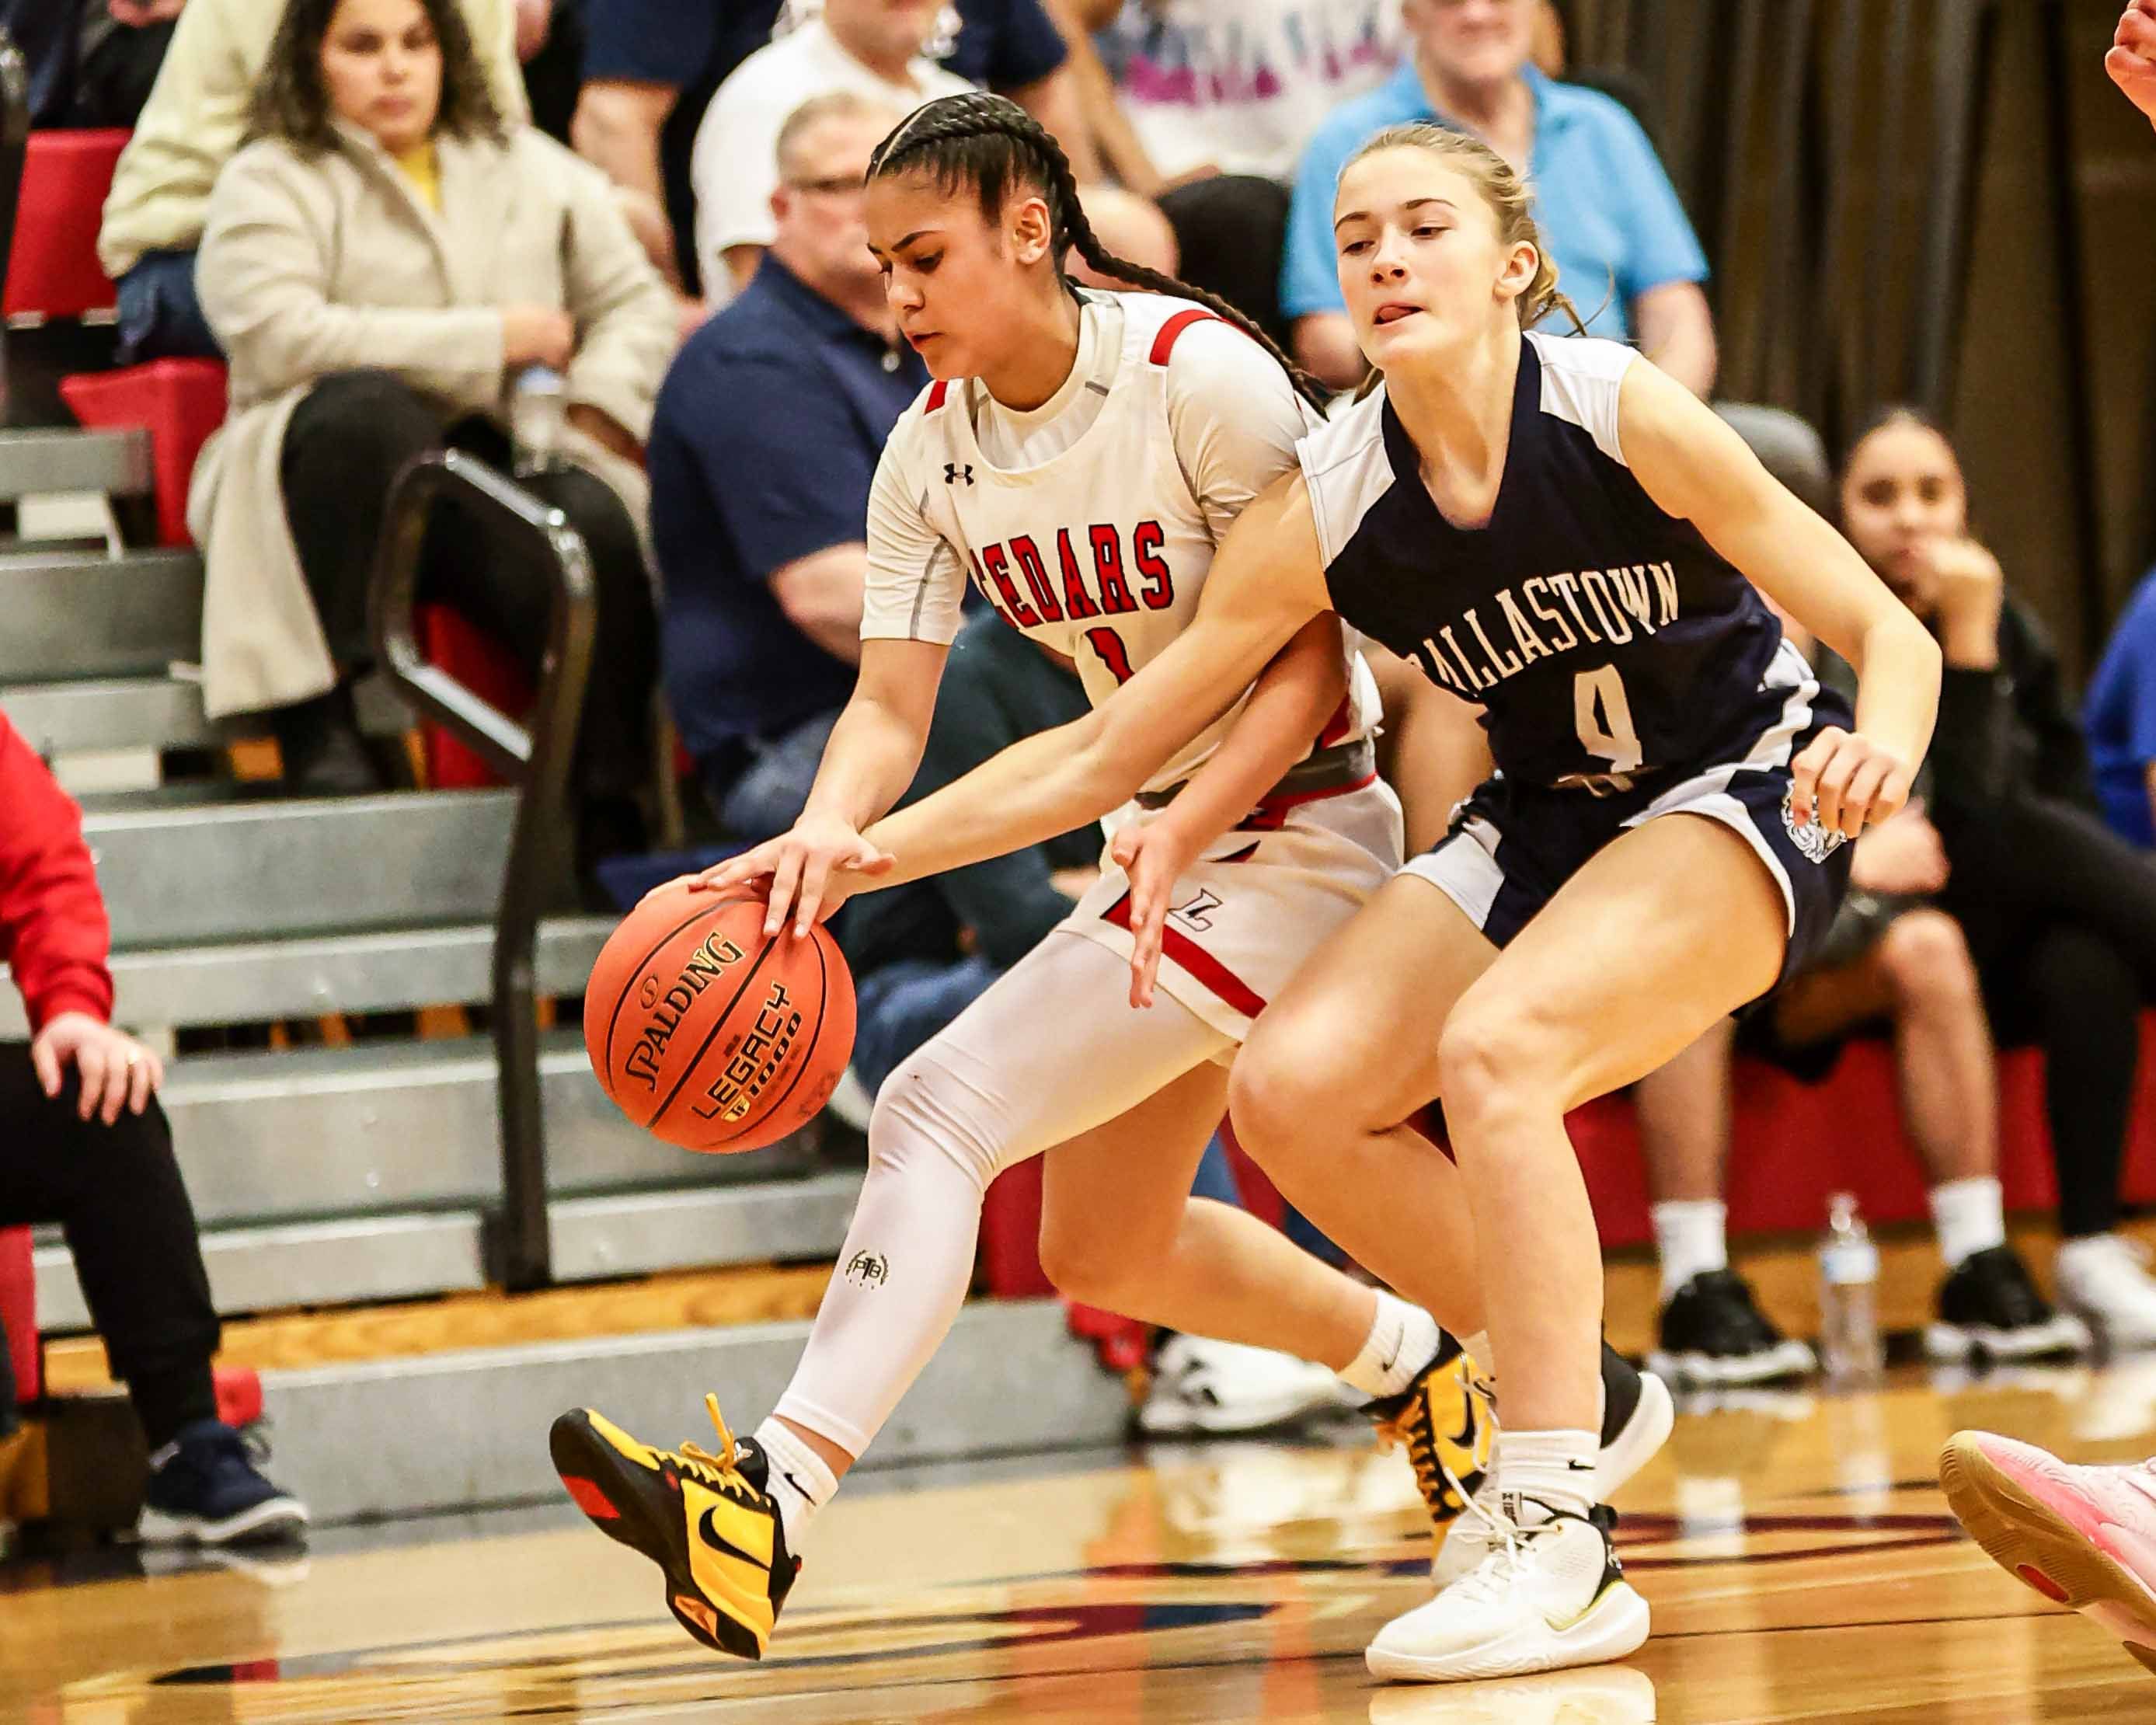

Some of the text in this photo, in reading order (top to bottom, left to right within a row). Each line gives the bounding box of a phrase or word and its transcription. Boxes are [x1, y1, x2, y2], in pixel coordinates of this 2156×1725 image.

[1409, 560, 1679, 698] ALLASTOWN
[625, 932, 747, 1093] SPALDING
[691, 981, 789, 1120] LEGACY
